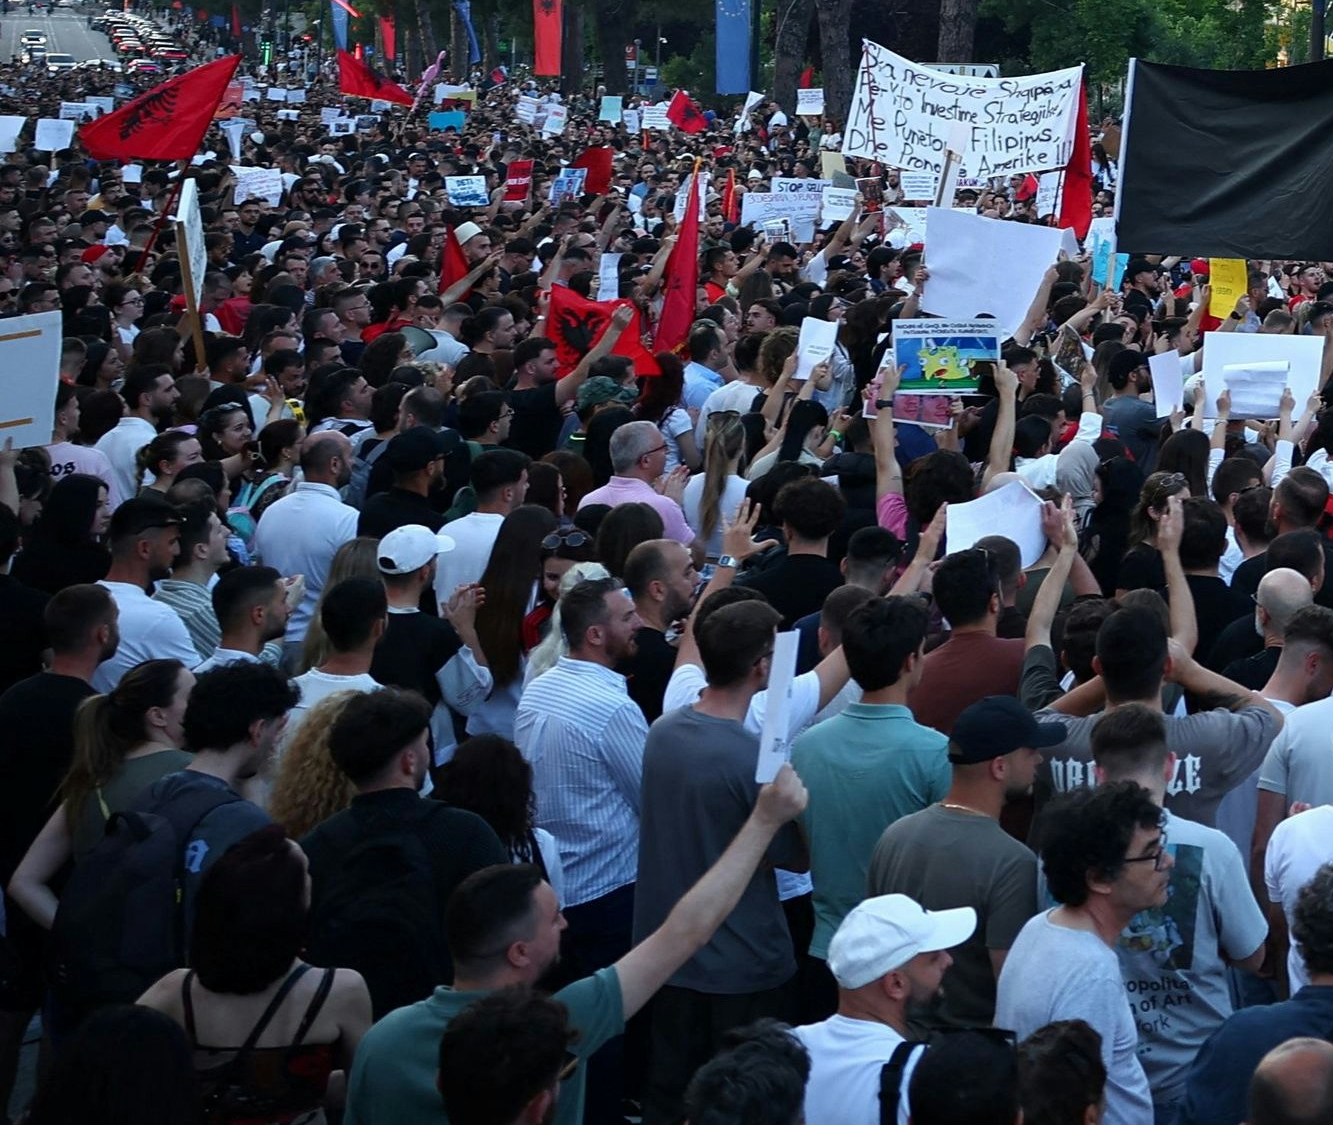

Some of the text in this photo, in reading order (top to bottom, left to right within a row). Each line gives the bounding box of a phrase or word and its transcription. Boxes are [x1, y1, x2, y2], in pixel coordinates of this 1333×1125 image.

[778, 181, 803, 193] STOP
[1126, 976, 1192, 995] opolita
[1140, 996, 1157, 1012] of
[1163, 993, 1192, 1009] Art
